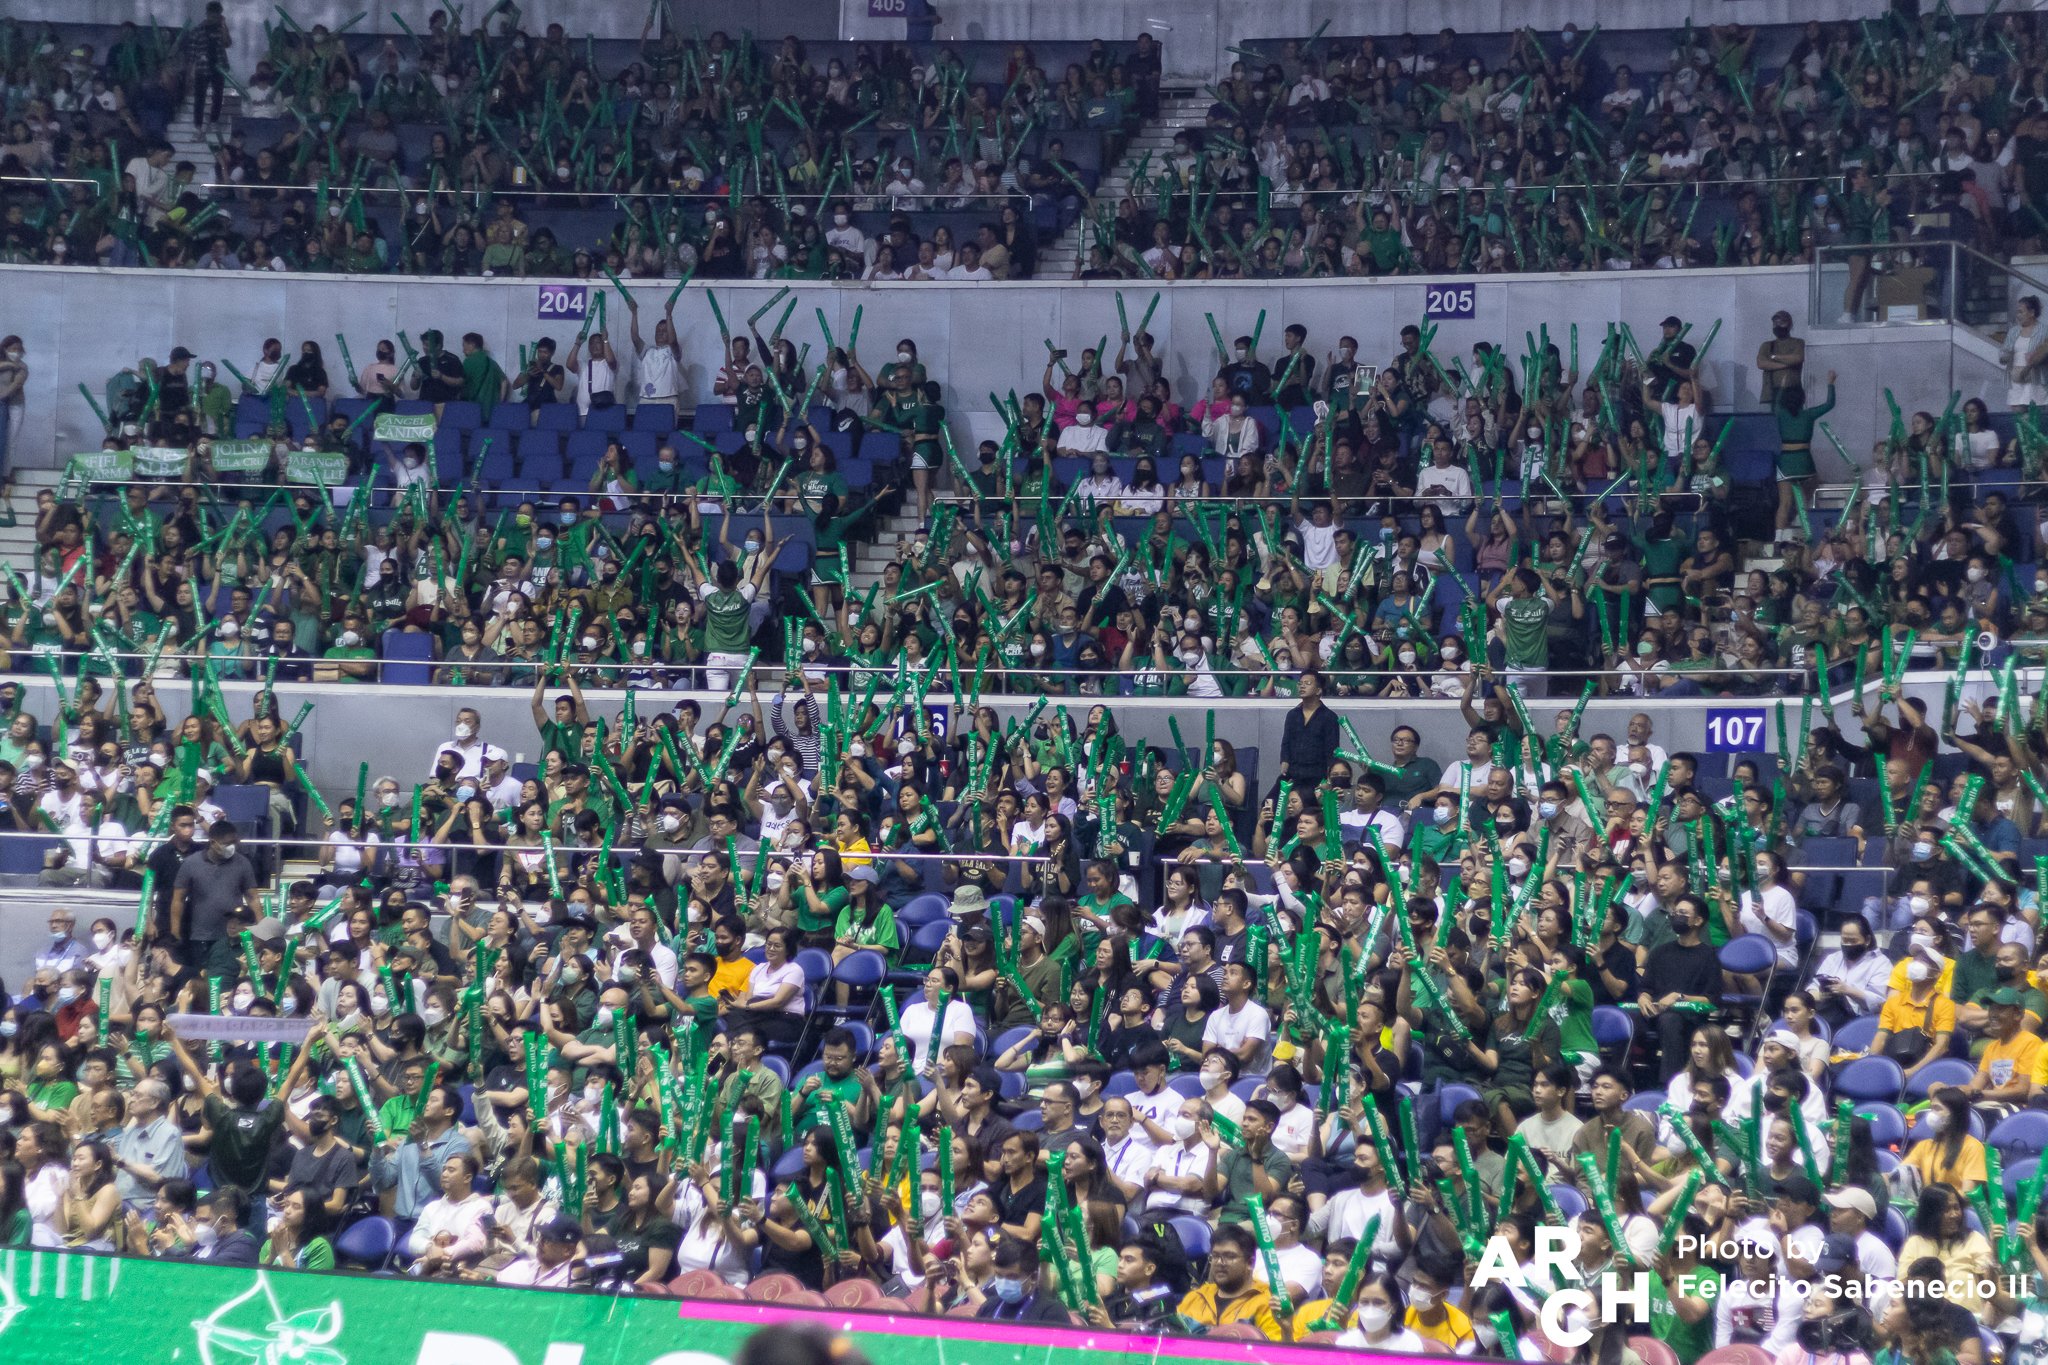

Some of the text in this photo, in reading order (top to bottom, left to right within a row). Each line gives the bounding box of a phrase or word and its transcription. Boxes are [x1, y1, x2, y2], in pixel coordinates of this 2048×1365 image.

[540, 291, 584, 314] 204
[1427, 290, 1473, 313] 205
[376, 426, 434, 438] CANINO
[384, 417, 427, 425] ANGEL
[87, 455, 117, 467] FIFI
[215, 443, 268, 458] JOLINA
[74, 469, 132, 481] SARMA
[136, 462, 185, 478] ALBA
[306, 468, 345, 481] SLLE
[896, 713, 946, 739] 16
[1708, 717, 1764, 745] 107
[1375, 760, 1398, 774] Animo
[1274, 789, 1285, 817] Animo
[1100, 807, 1109, 831] Animo
[1518, 873, 1539, 906] Animo
[1577, 880, 1585, 910] Animo
[247, 940, 258, 966] Animo
[1247, 934, 1257, 963] Animo
[384, 976, 395, 1002] Animo
[1008, 972, 1025, 998] Animo
[1286, 961, 1299, 991] Animo
[1419, 966, 1439, 994] Animo
[102, 988, 111, 1015] Animo
[210, 986, 220, 1011] Animo
[885, 996, 896, 1025] Animo
[473, 1002, 481, 1029] Animo
[616, 1019, 625, 1048] Animo
[529, 1042, 537, 1073] Animo
[351, 1064, 365, 1092] Animo
[684, 1082, 697, 1111] Salle
[666, 1109, 677, 1140] Animo
[834, 1111, 848, 1143] Animo
[840, 1099, 851, 1131] Animo
[880, 1107, 889, 1138] Animo
[1371, 1107, 1387, 1141] Animo
[1409, 1110, 1418, 1143] Animo
[724, 1120, 734, 1149] Salle
[1462, 1138, 1475, 1171] Anim
[1521, 1145, 1541, 1177] Animo
[1443, 1193, 1460, 1227] Animo
[1081, 1220, 1092, 1256] Animo
[1255, 1206, 1271, 1243] Animo
[1610, 1219, 1630, 1256] Animo
[1053, 1227, 1068, 1261] Animo
